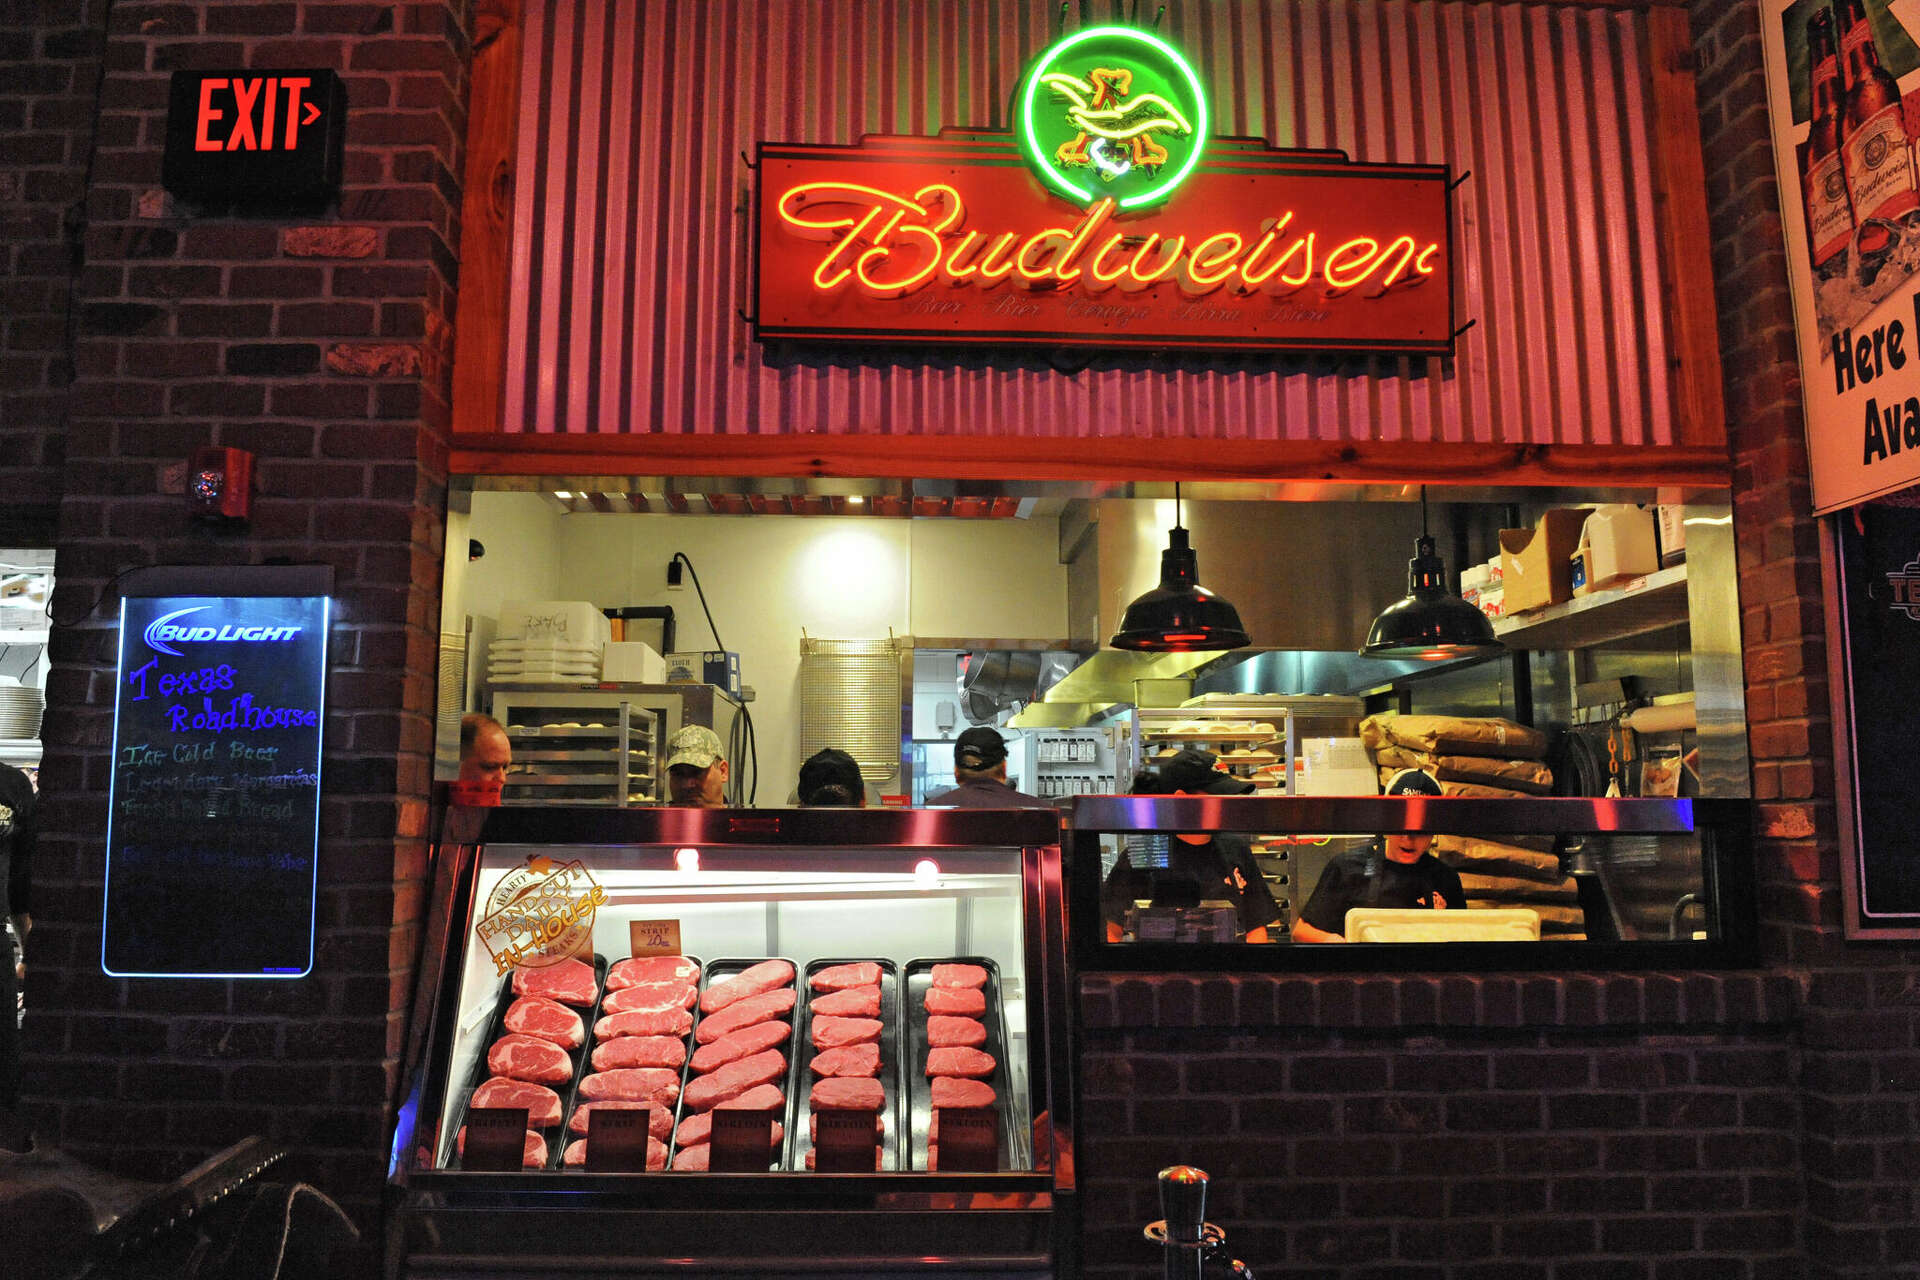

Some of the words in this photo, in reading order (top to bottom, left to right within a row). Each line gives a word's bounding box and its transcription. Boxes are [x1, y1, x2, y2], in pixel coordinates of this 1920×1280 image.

[195, 77, 311, 152] EXIT
[1854, 159, 1908, 206] Budweise
[778, 182, 1439, 291] Budweiser
[990, 294, 1041, 315] Bier
[1832, 319, 1907, 395] Here
[1863, 397, 1920, 466] Ava
[153, 624, 217, 642] BUD
[215, 624, 302, 642] LIGHT
[129, 655, 238, 701] Texas
[165, 692, 317, 734] Roadhouse
[173, 741, 216, 764] Cold
[480, 895, 539, 940] HAND
[540, 863, 581, 899] CUT
[496, 873, 527, 906] HEARTY
[505, 884, 575, 943] DAILY
[492, 885, 608, 977] IN-HOUSE
